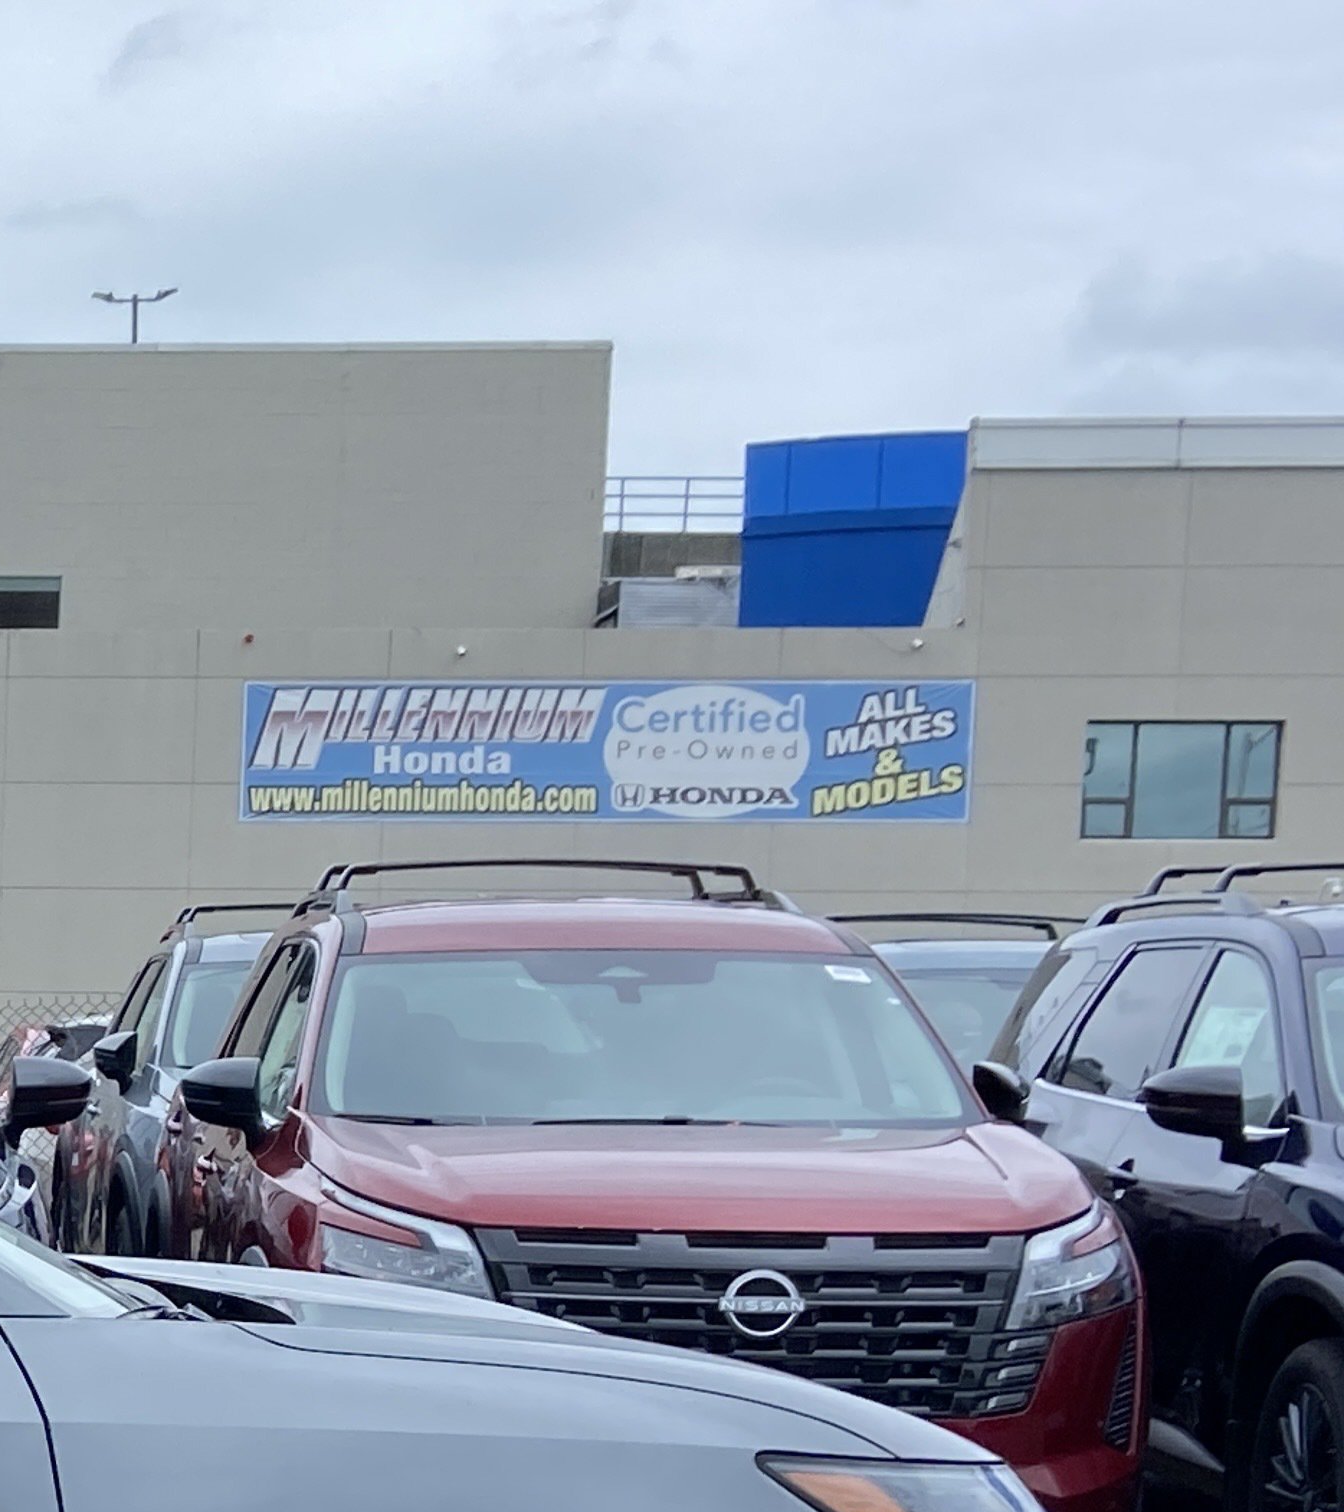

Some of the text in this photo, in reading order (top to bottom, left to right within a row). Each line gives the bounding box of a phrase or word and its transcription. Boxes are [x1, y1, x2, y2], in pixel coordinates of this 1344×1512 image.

[616, 699, 801, 734] Certified
[857, 686, 927, 724] ALL
[248, 688, 609, 769] MILLENNIUM
[825, 710, 958, 758] MAKES
[373, 745, 511, 775] Honda
[616, 740, 799, 761] Pre-Owned
[875, 748, 904, 775] &
[249, 778, 598, 813] www.millenniumhonda.com
[649, 788, 794, 805] HONDA
[812, 764, 965, 817] MODELS
[719, 1300, 805, 1312] NISSAN
